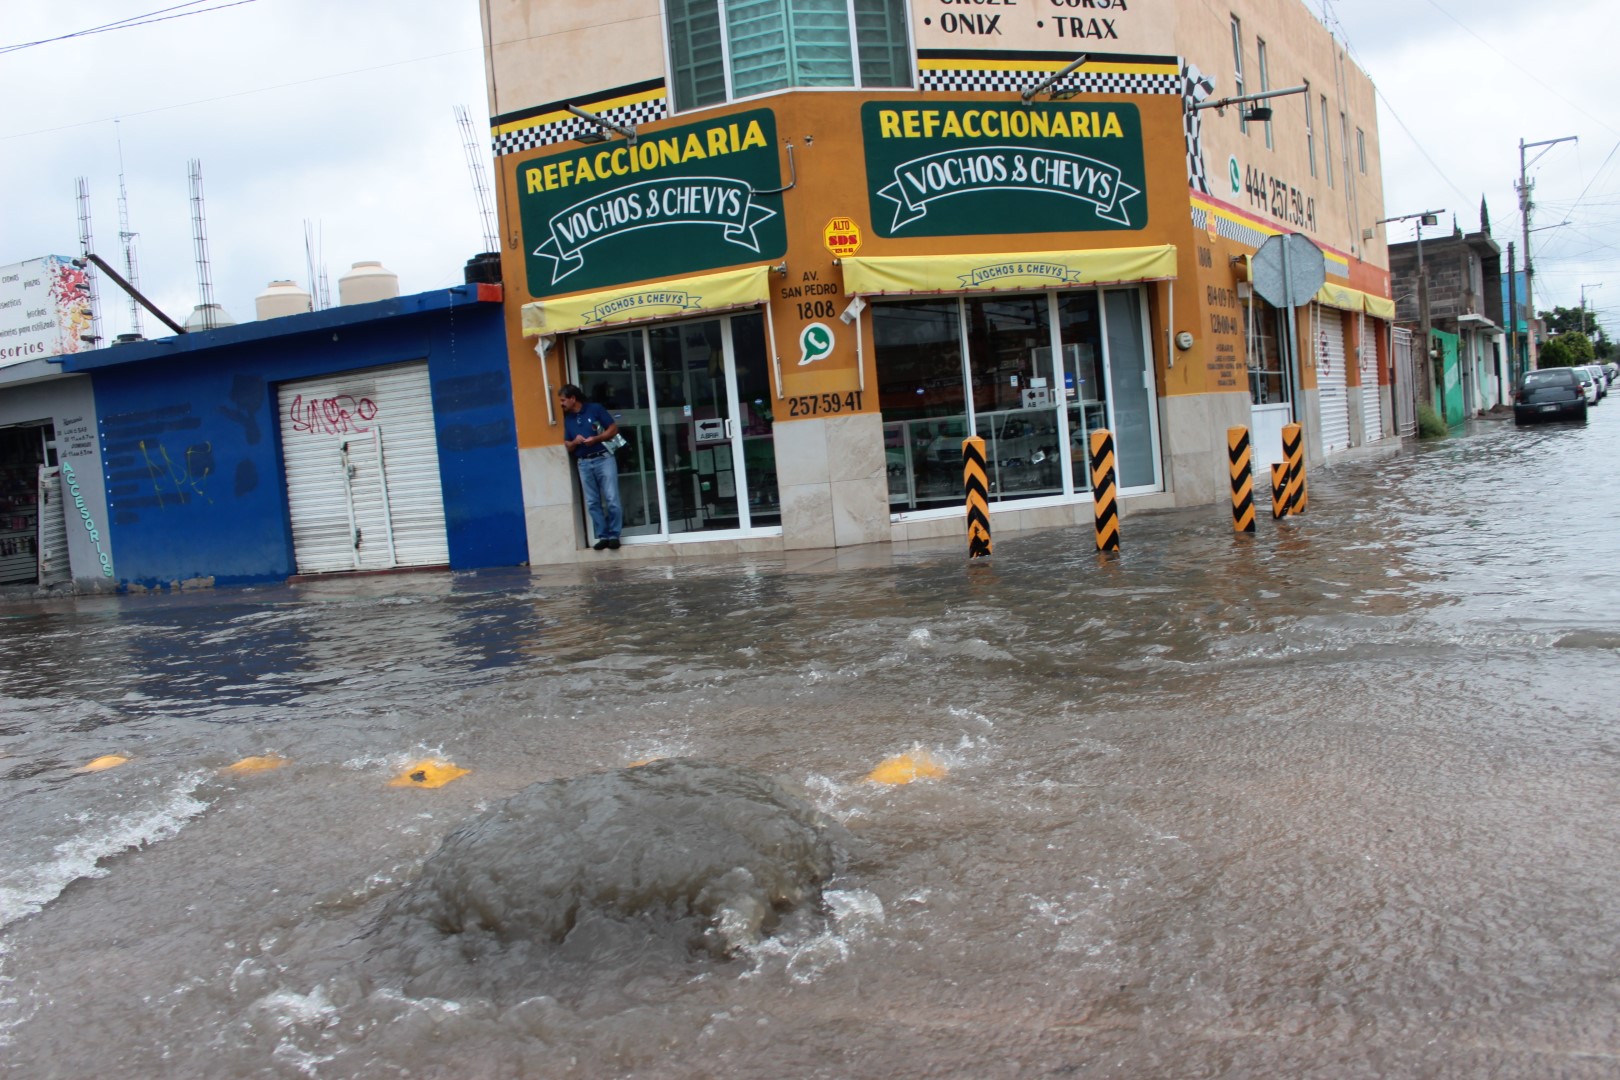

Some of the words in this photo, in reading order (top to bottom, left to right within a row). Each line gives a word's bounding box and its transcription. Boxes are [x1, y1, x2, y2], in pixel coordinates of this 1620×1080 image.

[940, 12, 1003, 36] ONIX
[1052, 16, 1118, 40] TRAX
[878, 110, 1124, 138] REFACCIONARIA
[525, 120, 768, 194] REFACCIONARIA
[904, 155, 1006, 194] VOCHOS
[1010, 154, 1027, 182] &
[1030, 156, 1113, 198] CHEVYS
[1245, 163, 1267, 212] 444
[556, 192, 642, 244] VOCHOS
[645, 190, 659, 218] &
[662, 186, 742, 217] CHEVYS
[833, 220, 850, 230] ALTO
[828, 234, 858, 245] SDS
[802, 271, 819, 282] AV.
[976, 265, 1015, 280] VOCHOS
[1017, 264, 1023, 273] &
[1027, 264, 1062, 276] CHEVYS
[781, 286, 802, 299] SAN
[804, 283, 838, 296] PEDRO
[598, 297, 635, 316] VOCHOS
[637, 295, 644, 305] &
[646, 293, 683, 304] CHEVYS
[797, 300, 836, 320] 1808
[62, 461, 113, 578] ACCESORIOS
